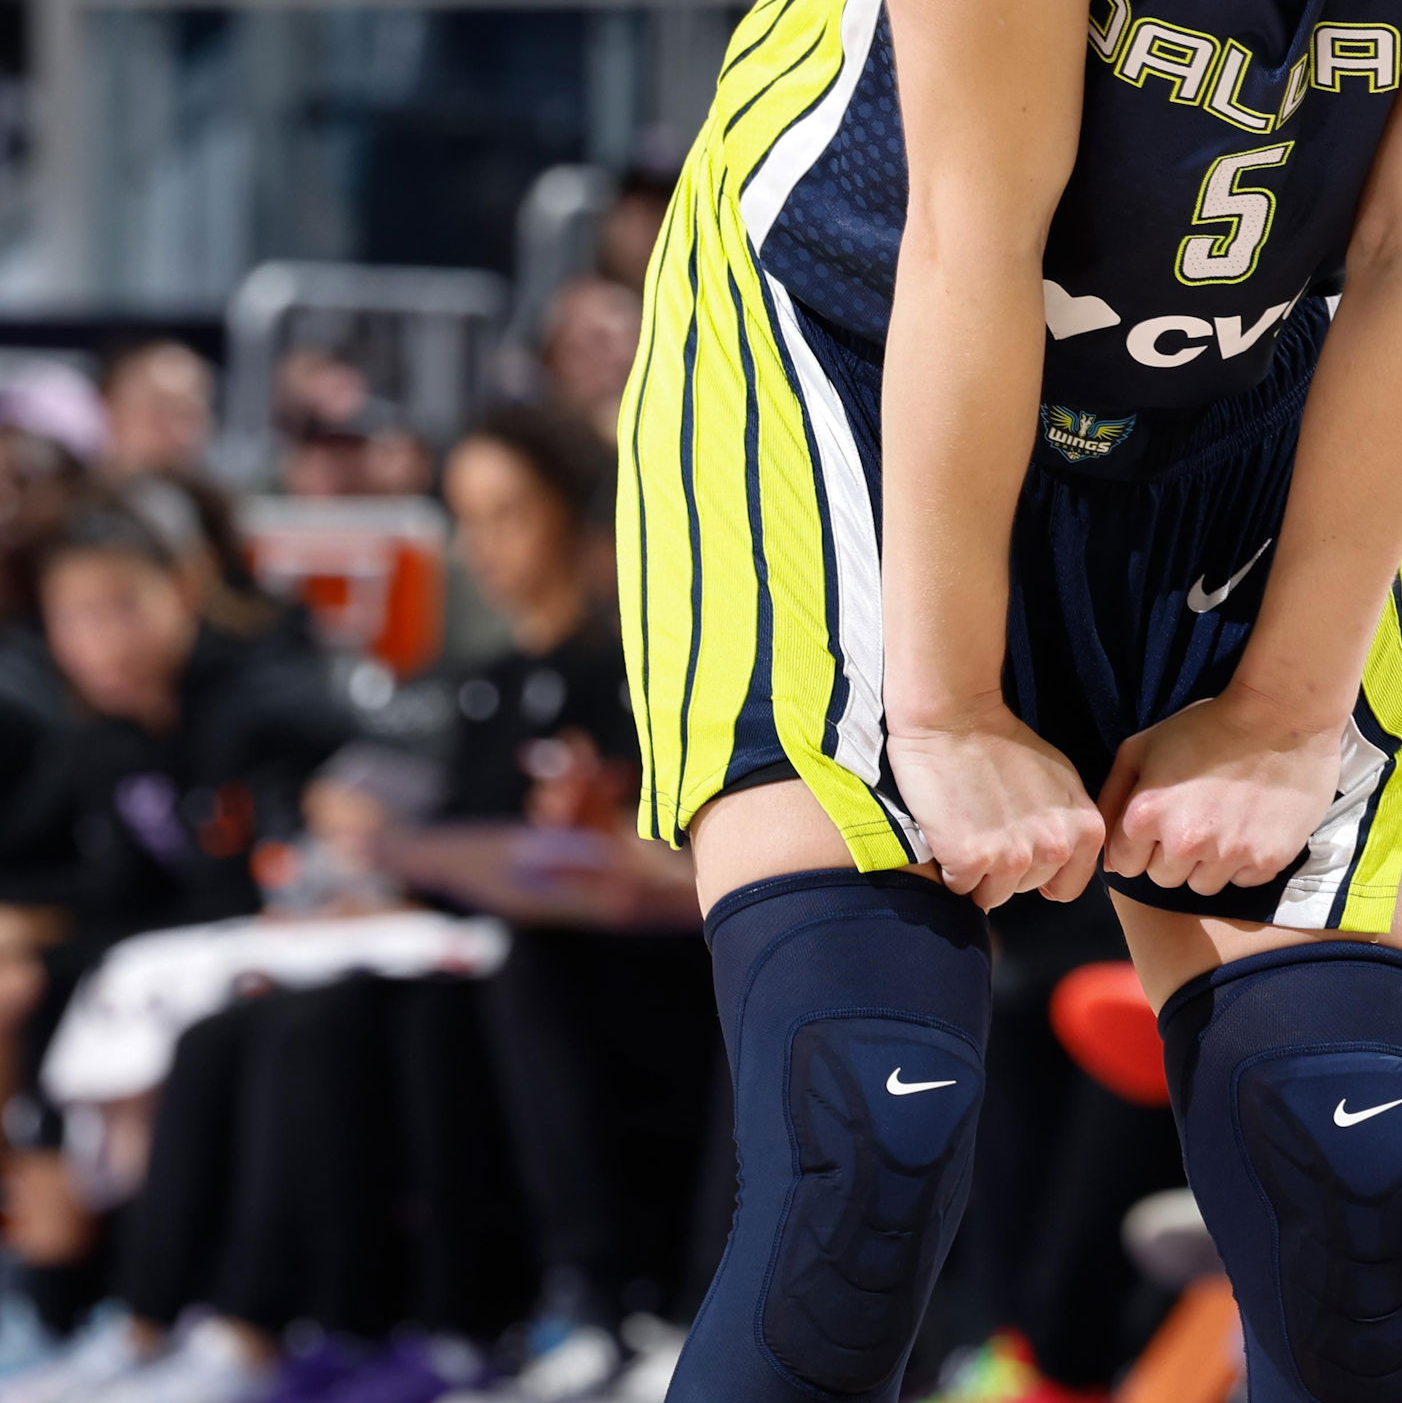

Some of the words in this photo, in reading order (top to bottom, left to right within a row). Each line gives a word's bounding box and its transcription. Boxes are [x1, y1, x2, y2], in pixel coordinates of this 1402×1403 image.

[1174, 140, 1295, 287] 5
[1126, 276, 1312, 368] CV
[1048, 427, 1112, 453] WINGS
